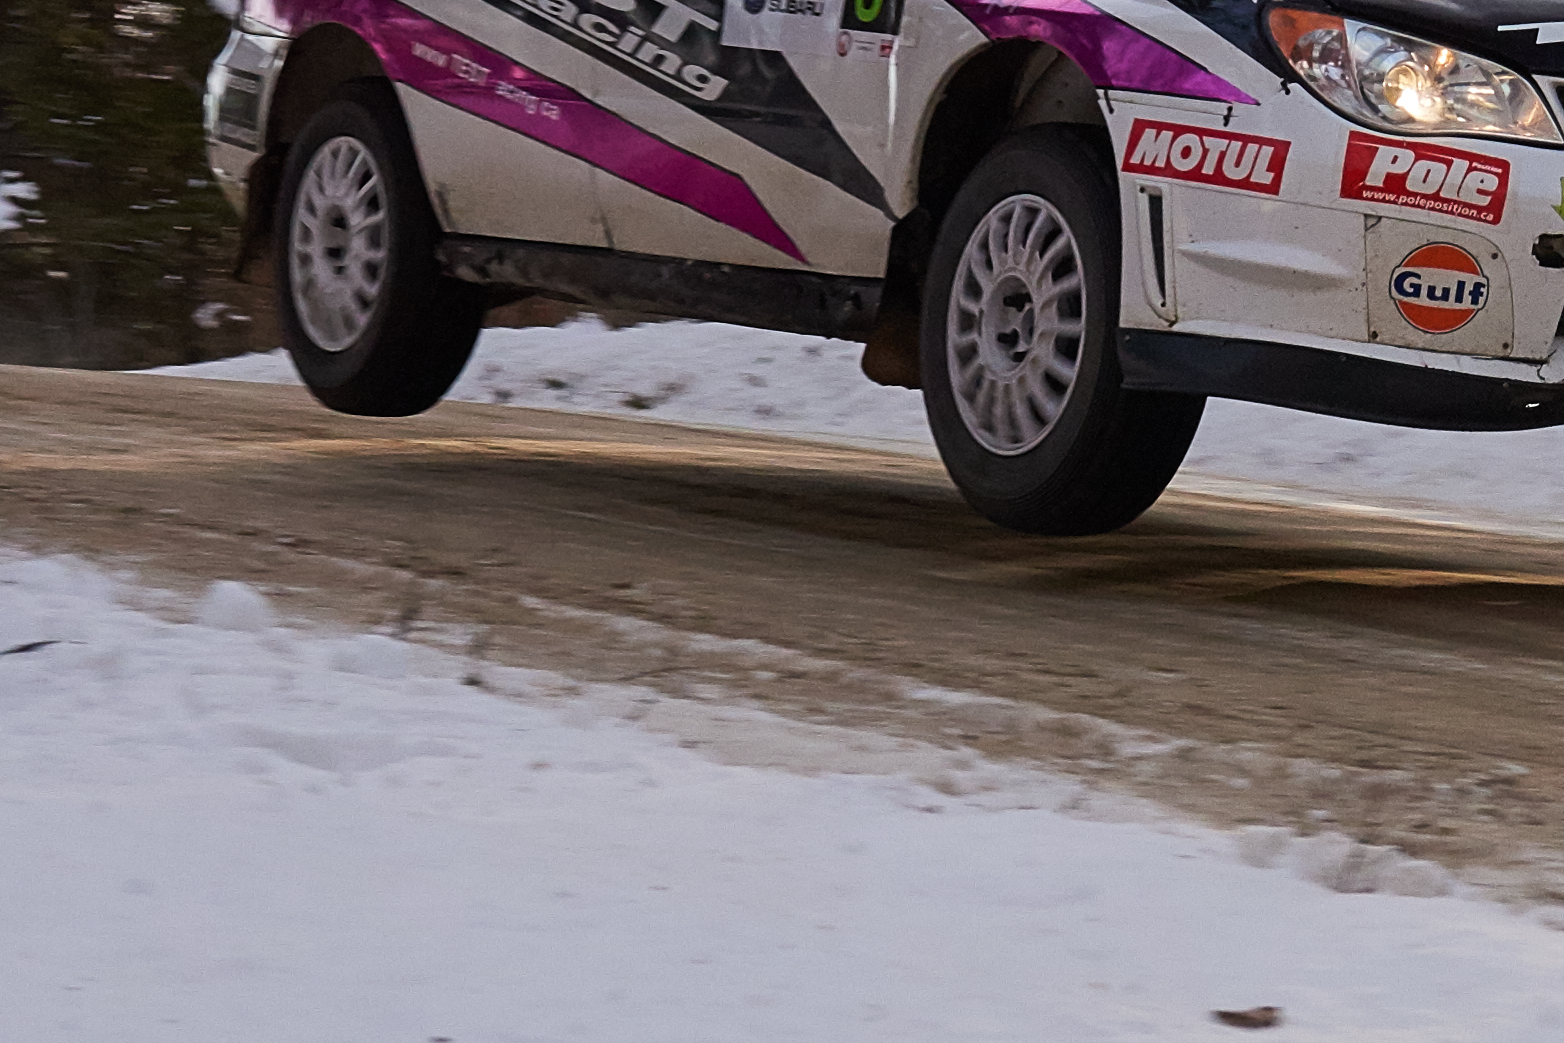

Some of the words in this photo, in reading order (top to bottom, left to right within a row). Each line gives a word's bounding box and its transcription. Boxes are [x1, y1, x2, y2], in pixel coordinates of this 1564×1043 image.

[1129, 128, 1276, 185] MOTUL
[1362, 144, 1500, 207] Pole
[1362, 188, 1495, 222] www.poleposition.ca
[1393, 271, 1488, 307] Gulf
